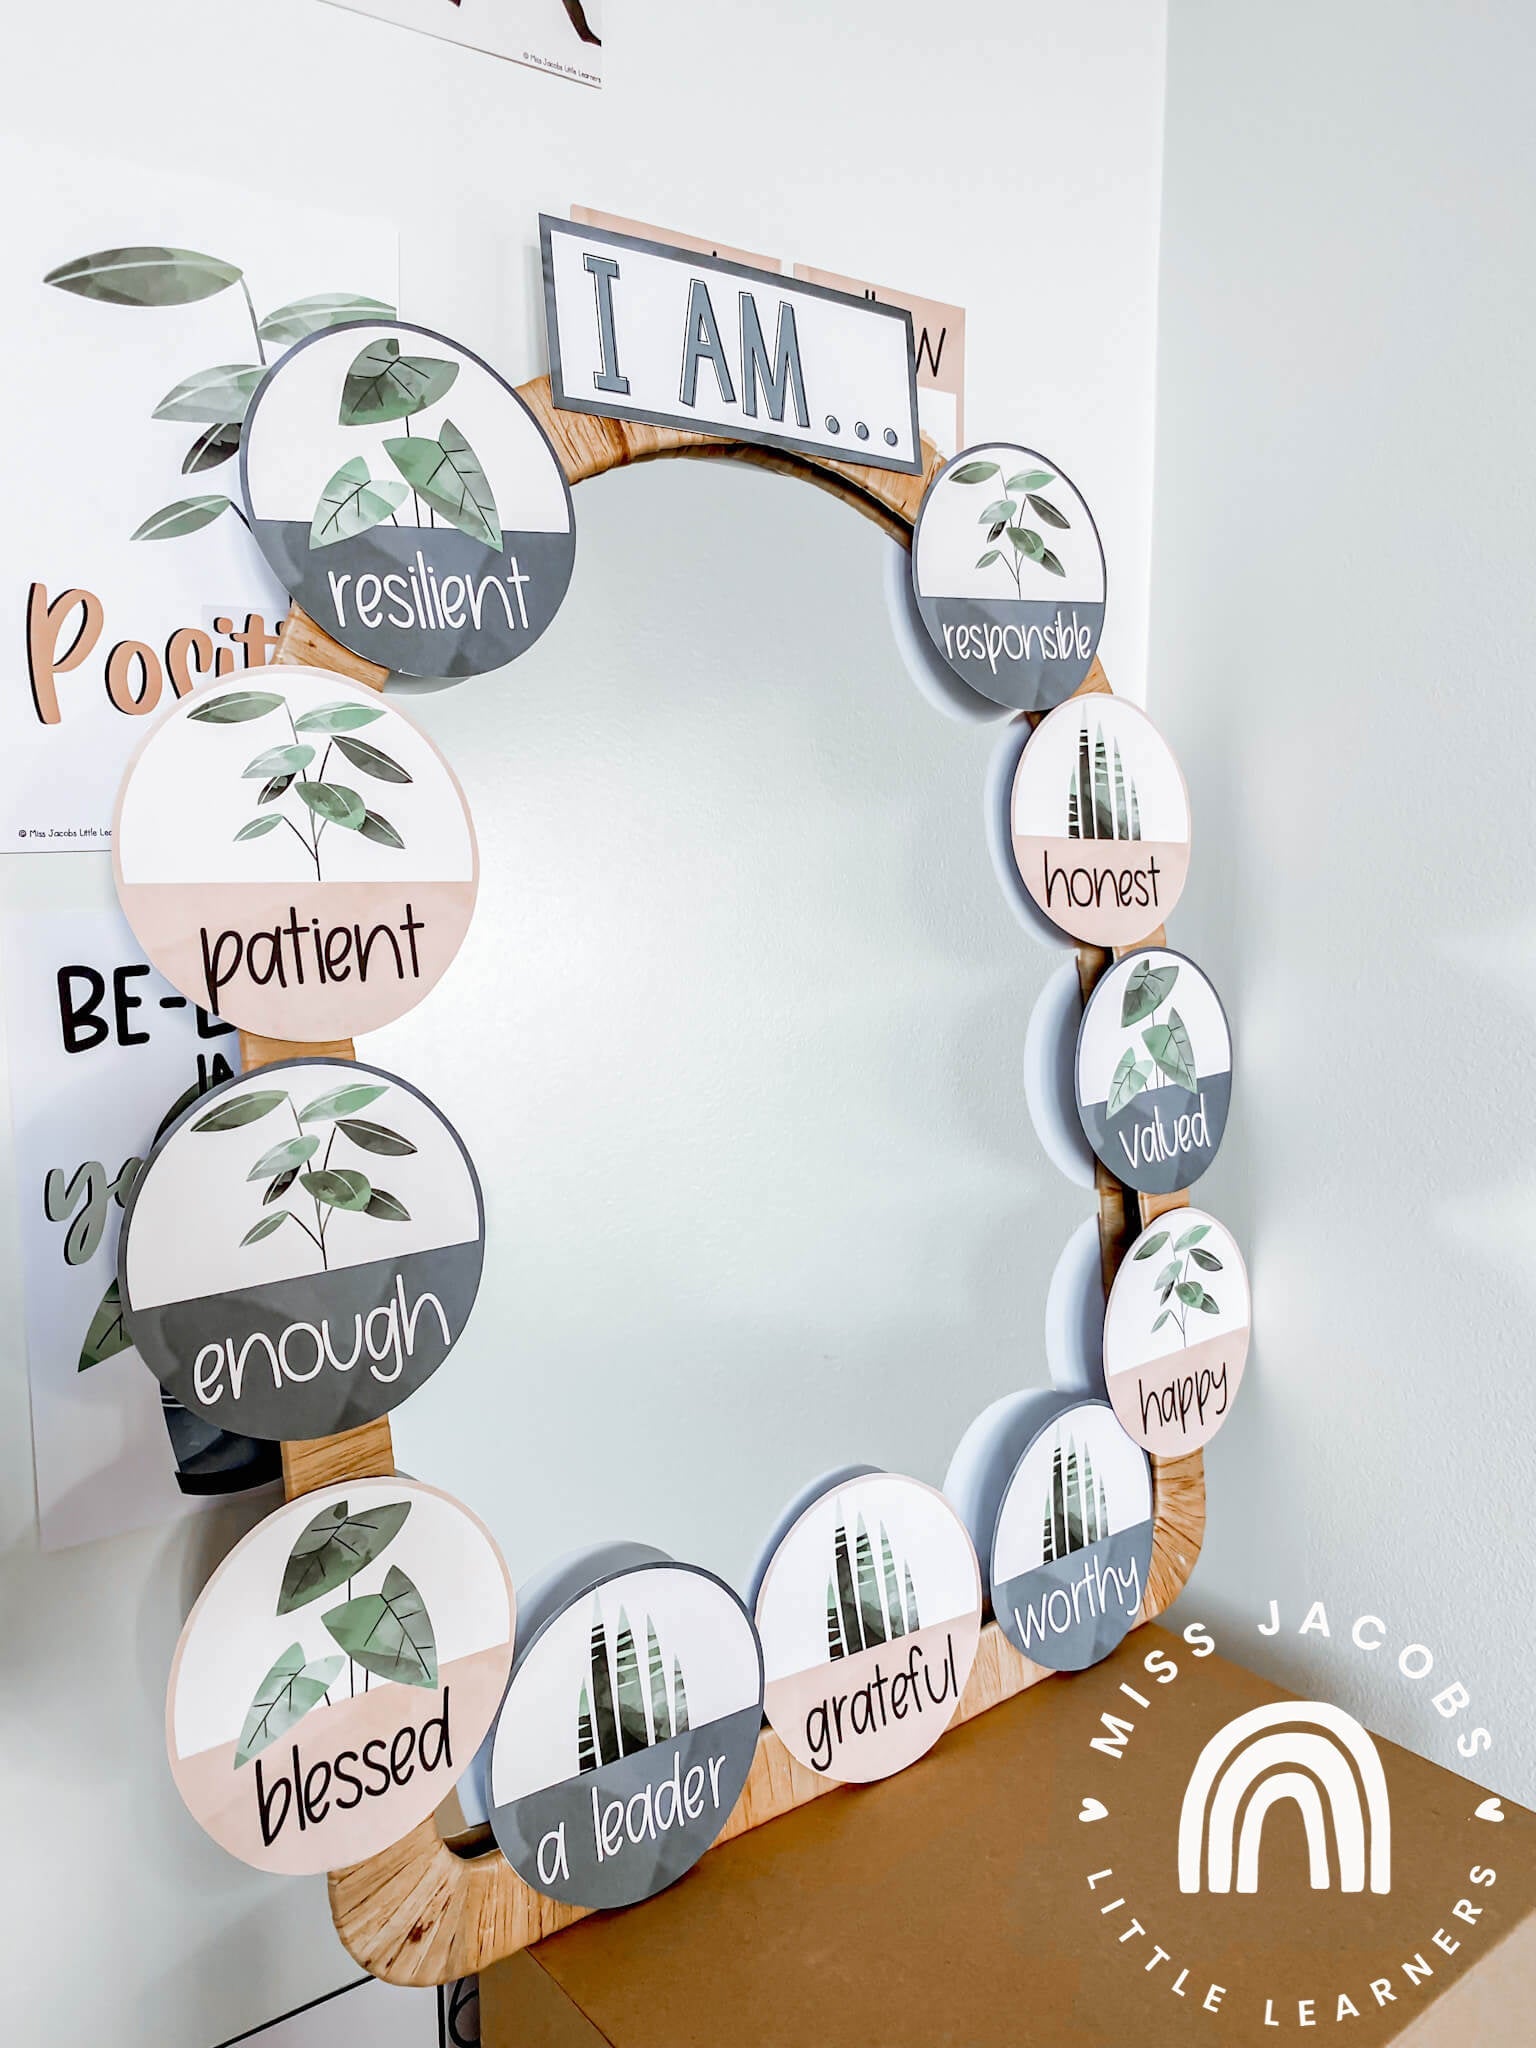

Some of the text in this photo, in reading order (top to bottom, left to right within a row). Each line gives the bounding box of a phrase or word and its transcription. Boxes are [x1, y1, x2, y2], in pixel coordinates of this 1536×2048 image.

[583, 253, 630, 395] I
[679, 279, 899, 447] AM...
[327, 550, 530, 630] resilient
[26, 582, 283, 725] Posit
[941, 610, 1092, 675] responsible
[29, 829, 46, 838] Miss
[48, 828, 77, 838] Jacobs
[79, 828, 98, 837] Little
[1043, 849, 1161, 908] honest
[200, 903, 425, 1016] patient
[1118, 1092, 1211, 1169] valued
[193, 1274, 451, 1406] enough
[1138, 1361, 1228, 1435] happy
[1014, 1554, 1142, 1650] worthy
[805, 1633, 958, 1771] grateful
[254, 1685, 453, 1848] blessed
[536, 1751, 727, 1885] a leader
